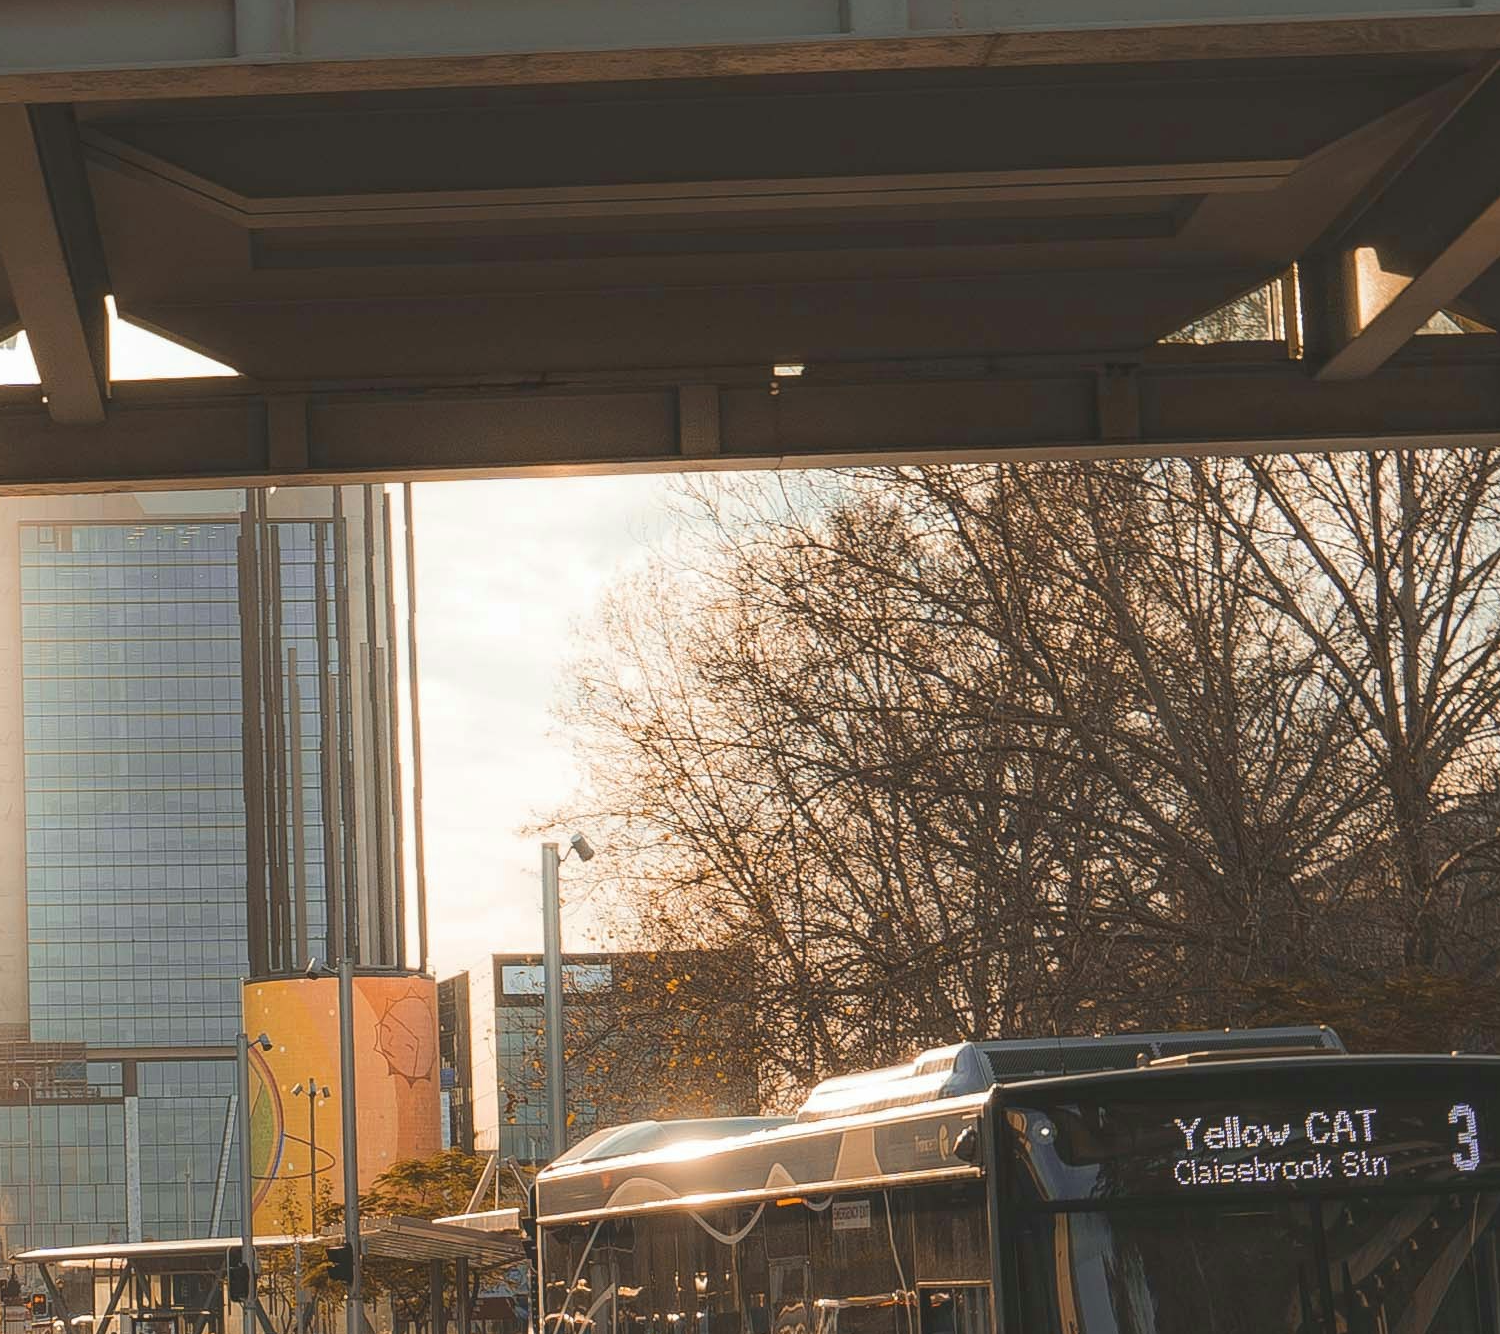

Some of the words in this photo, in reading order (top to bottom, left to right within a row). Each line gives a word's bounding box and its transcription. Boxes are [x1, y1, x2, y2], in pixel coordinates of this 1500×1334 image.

[1173, 1114, 1291, 1151] Yellow
[1304, 1108, 1378, 1145] CAT
[1447, 1102, 1481, 1173] 3
[1173, 1153, 1334, 1186] Claisebrook
[1341, 1150, 1391, 1178] Stn
